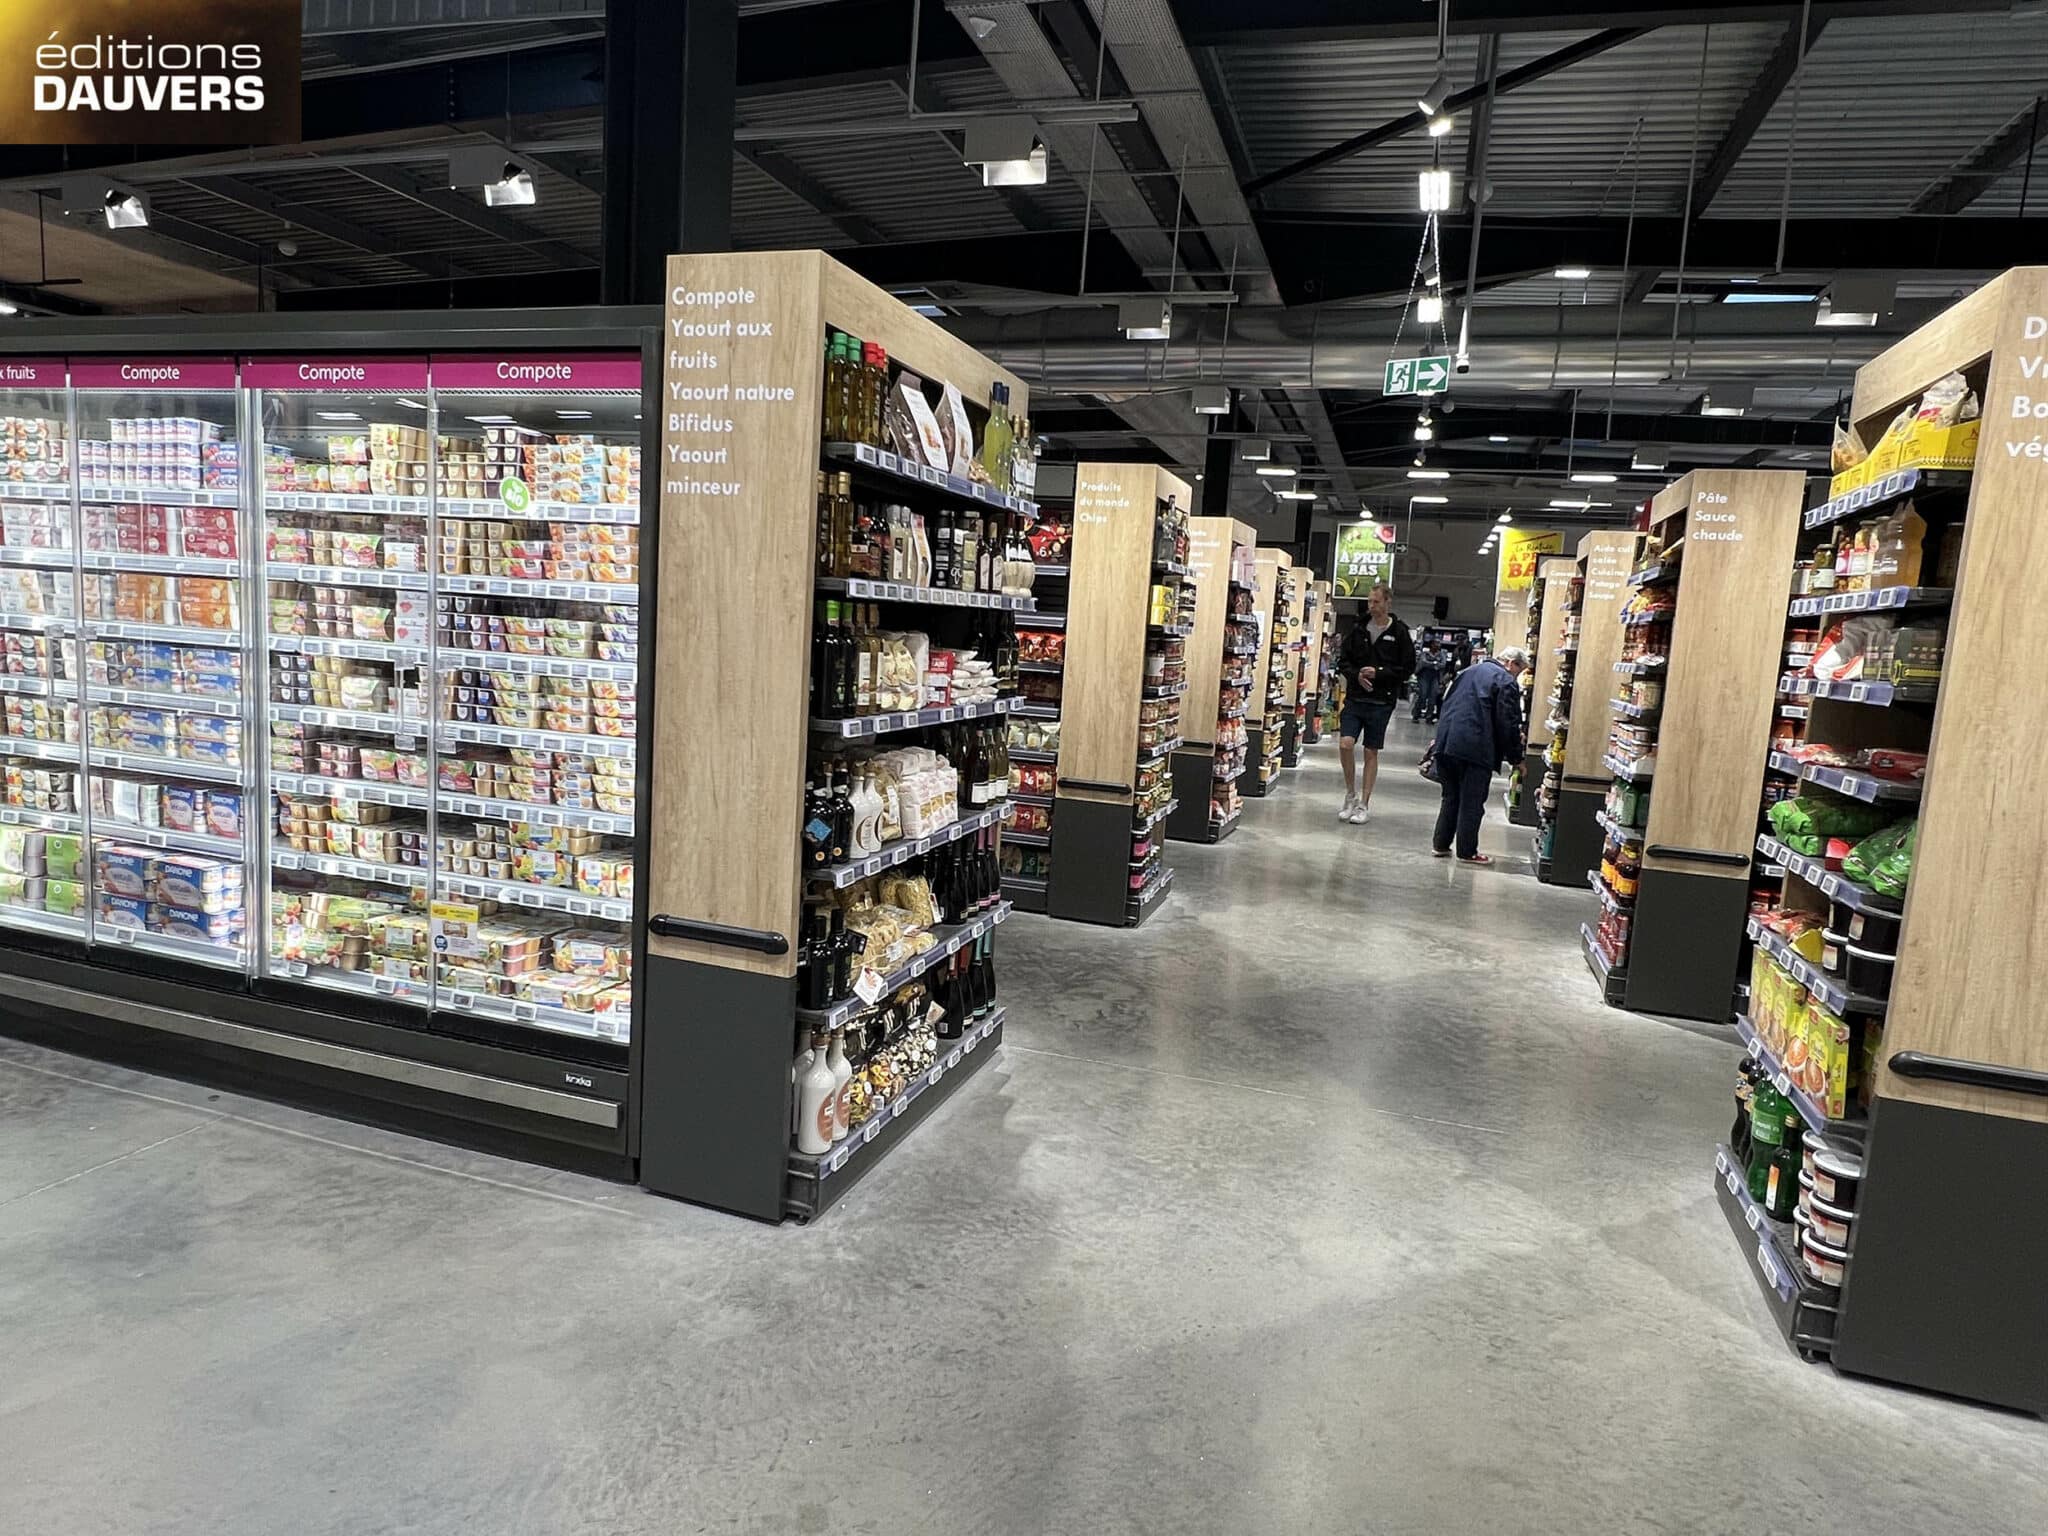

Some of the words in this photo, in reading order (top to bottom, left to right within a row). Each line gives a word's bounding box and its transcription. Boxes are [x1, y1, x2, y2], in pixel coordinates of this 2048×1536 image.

[672, 286, 756, 309] Compote
[672, 318, 731, 338] Yaourt
[736, 321, 773, 338] aux
[670, 349, 718, 369] fruits
[6, 365, 37, 380] fruits
[121, 364, 180, 383] Compote
[298, 363, 366, 385] Compote
[496, 360, 573, 384] Compote
[670, 382, 730, 402] Yaourt
[735, 383, 795, 402] nature
[668, 412, 734, 433] Bifidus
[667, 445, 728, 465] Yaourt
[667, 475, 741, 497] minceur
[1081, 481, 1122, 493] Produits
[1079, 497, 1093, 507] du
[1095, 497, 1130, 508] monde
[1697, 491, 1729, 505] Pâte
[1079, 513, 1108, 526] Chips
[1695, 510, 1737, 523] Sauce
[1692, 529, 1744, 542] chaude
[1352, 553, 1390, 564] PRIX
[1348, 564, 1378, 576] BAS
[1591, 568, 1626, 577] Cuisine
